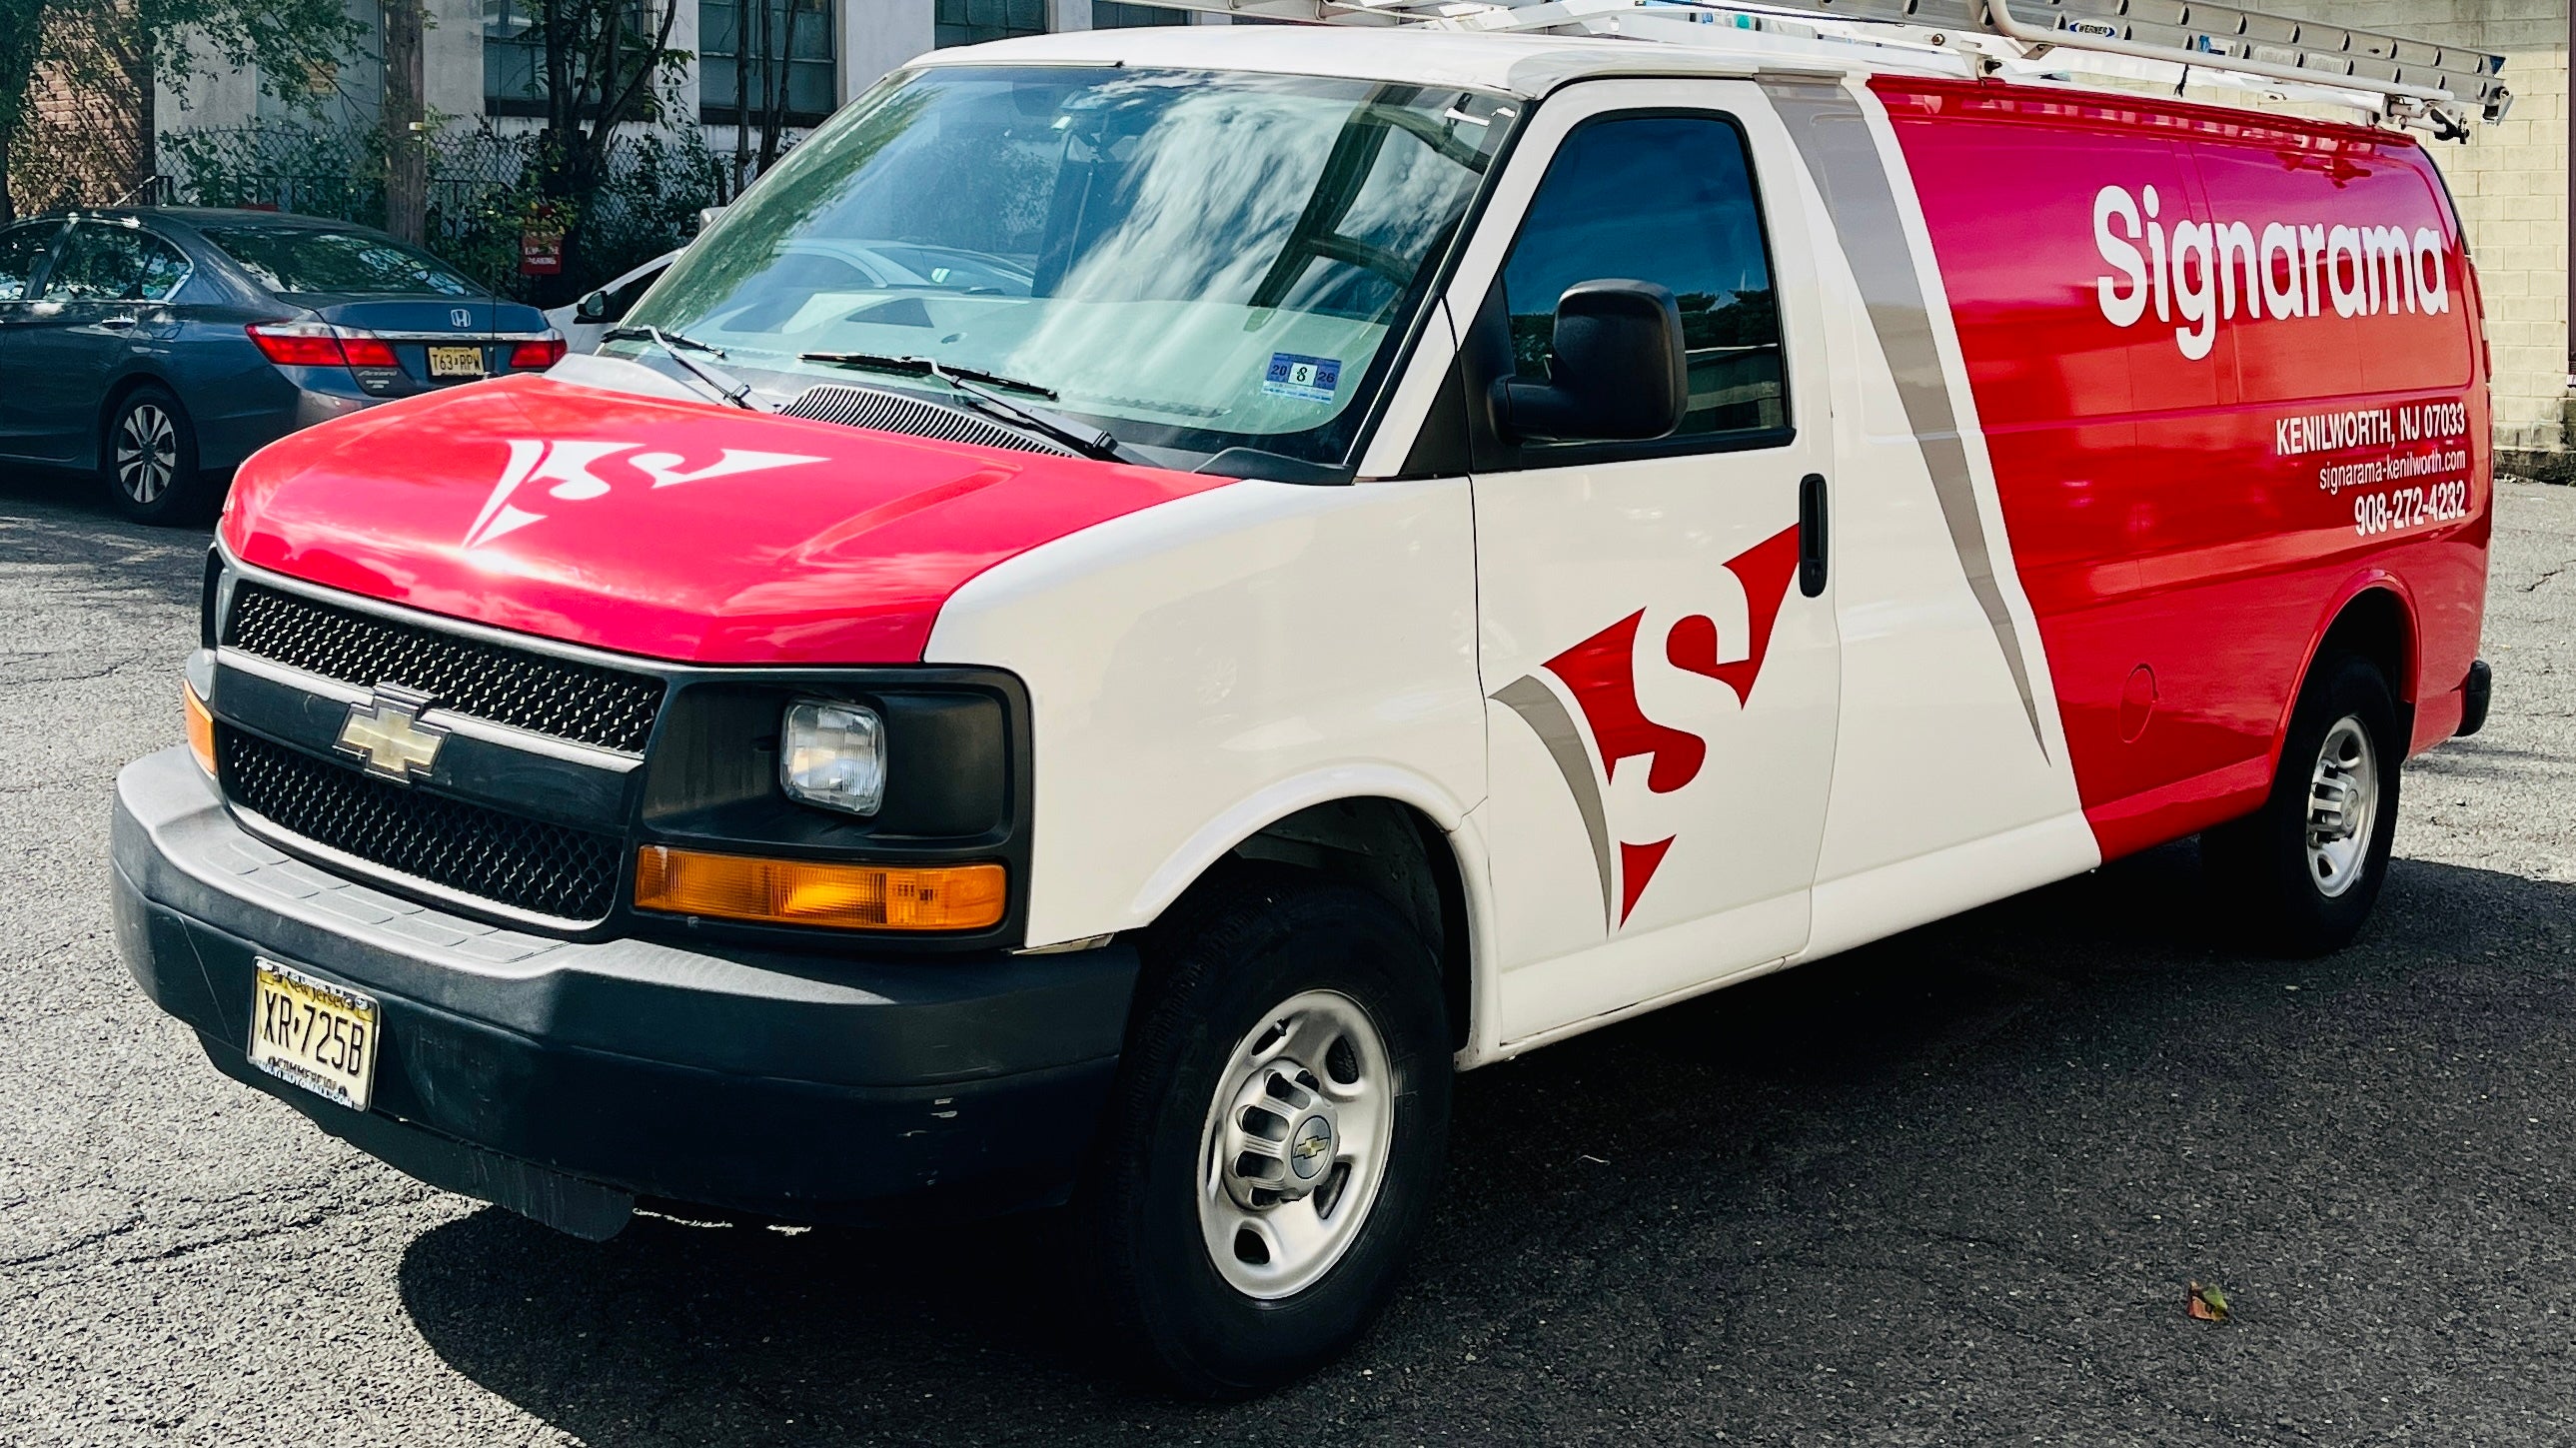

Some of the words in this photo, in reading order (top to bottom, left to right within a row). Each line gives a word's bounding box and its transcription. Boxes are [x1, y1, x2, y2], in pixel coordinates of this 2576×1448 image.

[2078, 24, 2107, 35] WERNER
[2093, 184, 2449, 361] Signarama
[1271, 364, 1288, 377] 20
[1296, 366, 1308, 382] 8
[1317, 372, 1336, 383] 26
[2275, 408, 2396, 456] KENILWORTH,
[2399, 406, 2420, 441] NJ
[2424, 402, 2465, 439] 07033
[2319, 449, 2466, 496] signarama-kenilworth.com
[2354, 480, 2466, 537] 908-272-4232
